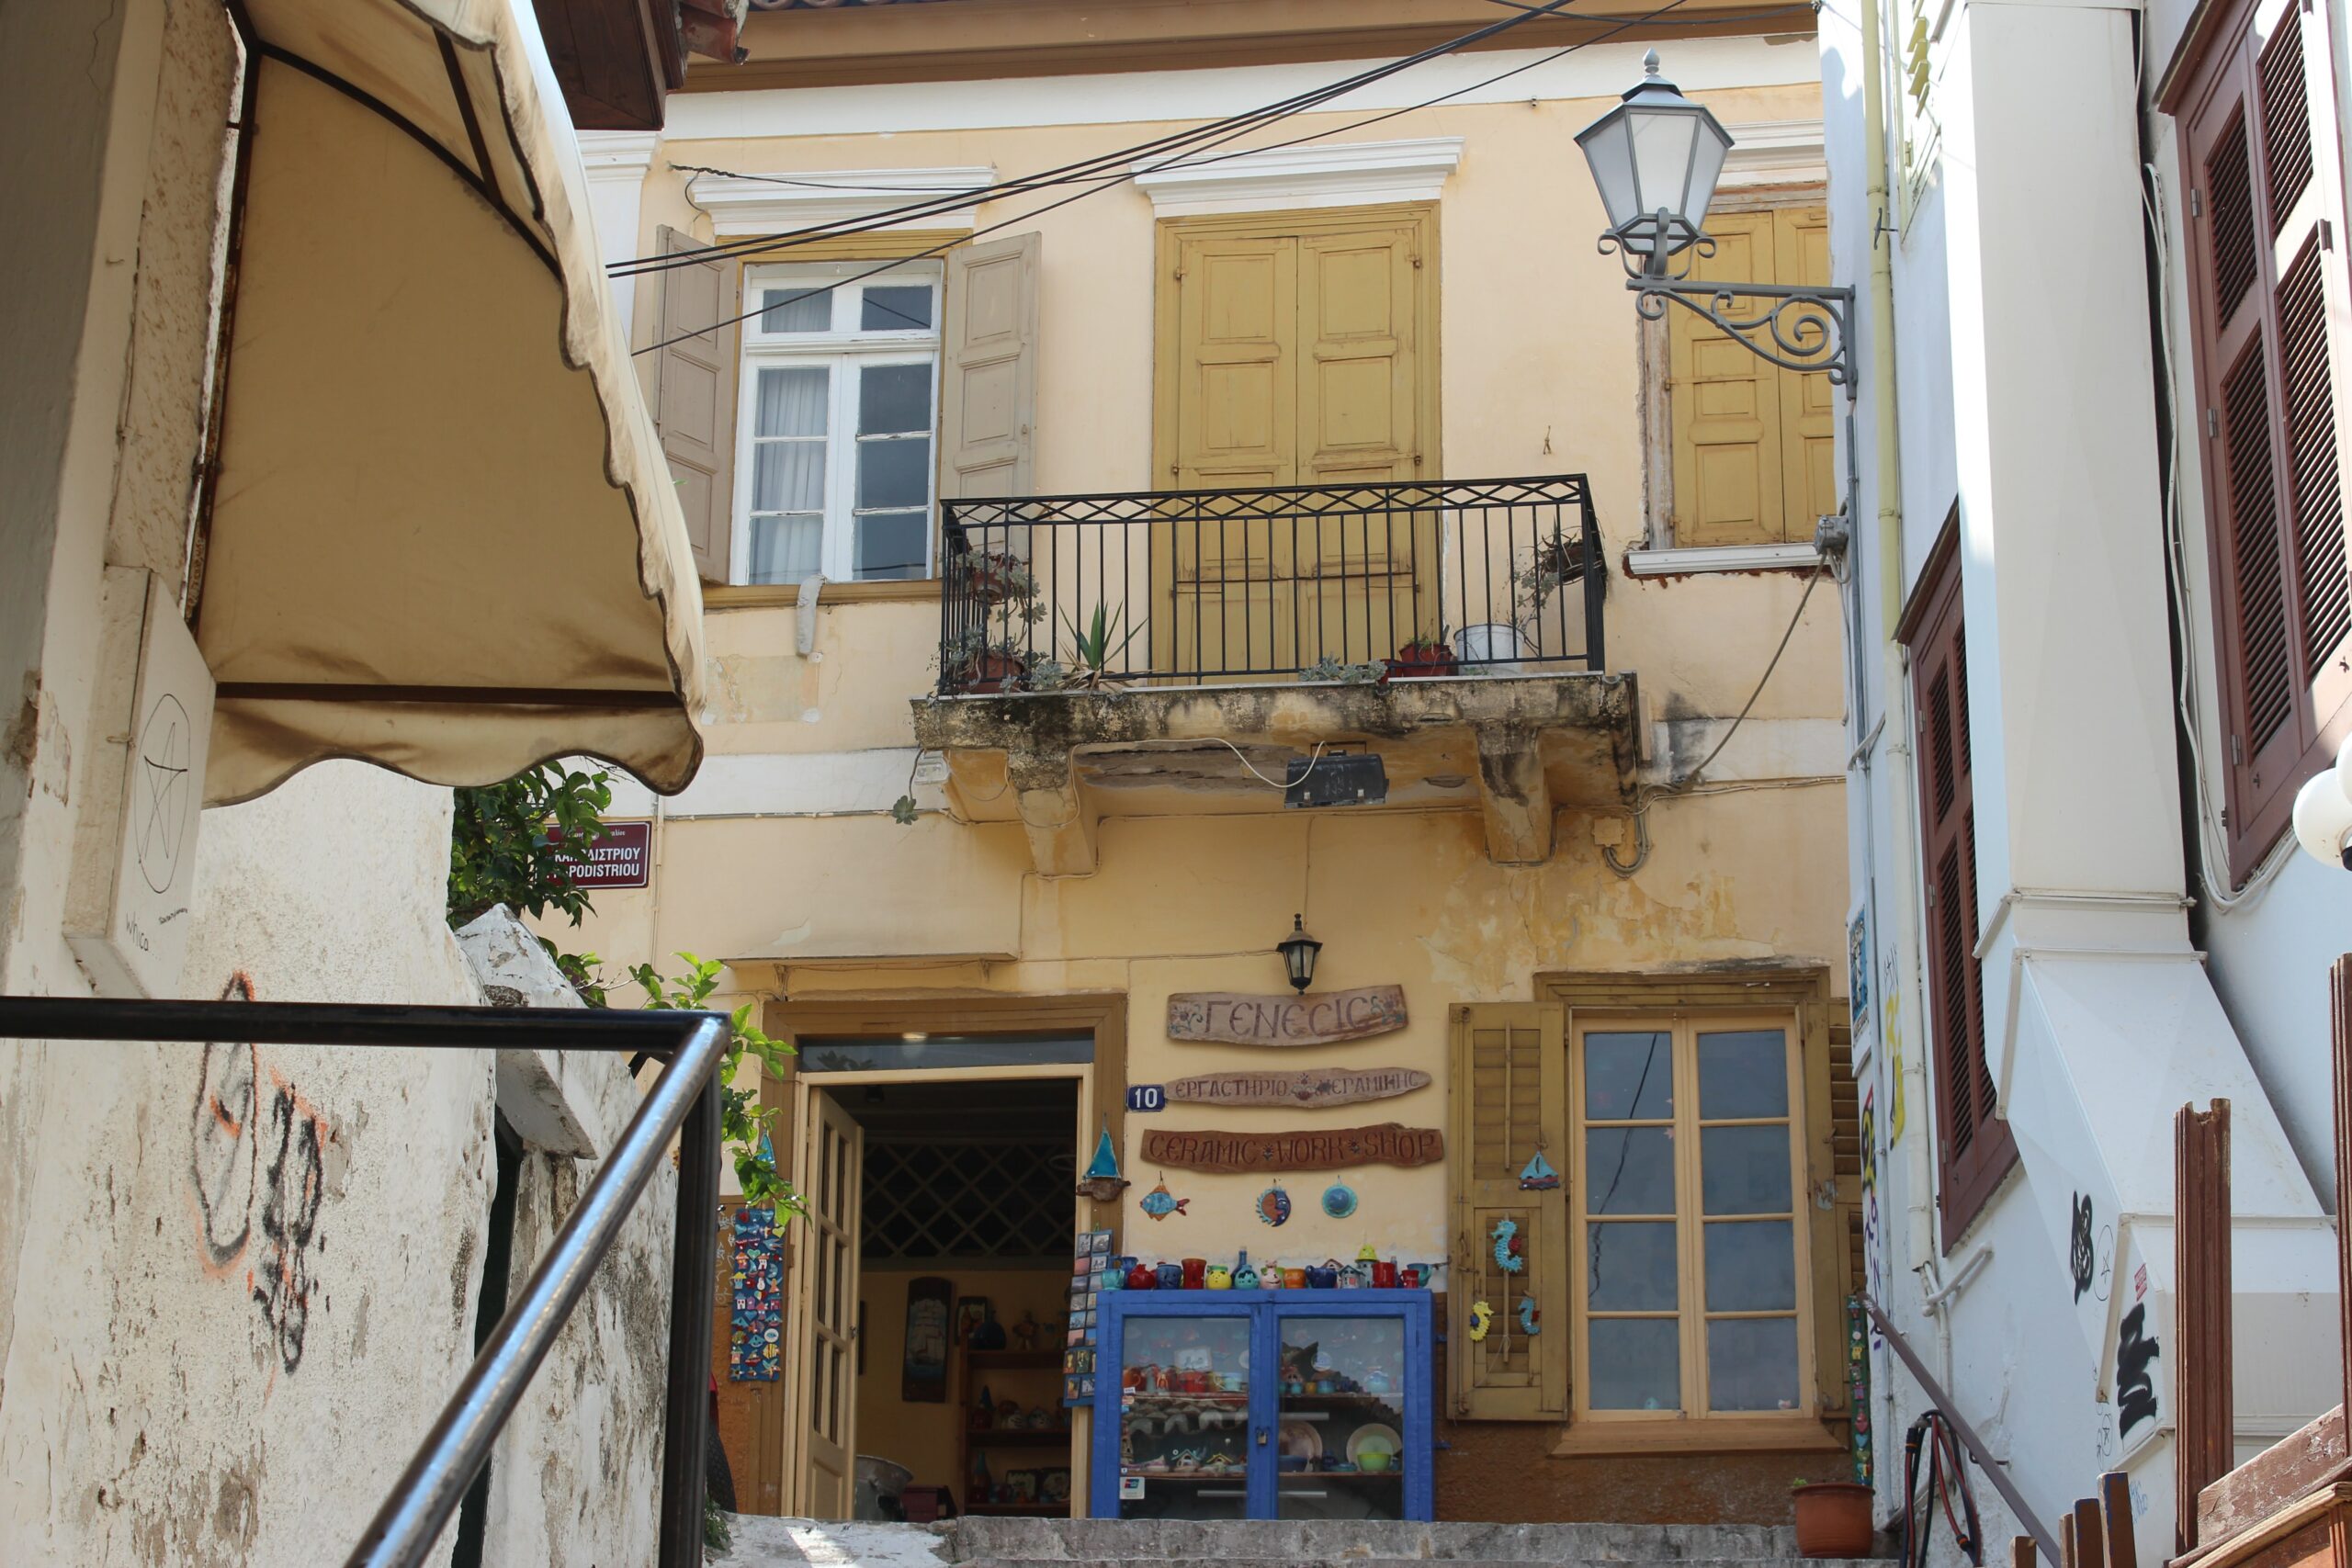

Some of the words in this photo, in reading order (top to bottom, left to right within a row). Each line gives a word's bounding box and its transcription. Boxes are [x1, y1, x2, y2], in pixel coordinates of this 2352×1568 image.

[1135, 1088, 1158, 1108] 10
[1149, 1134, 1257, 1165] CERAMIC
[1276, 1136, 1345, 1163] WORK
[1364, 1132, 1434, 1158] SHOP
